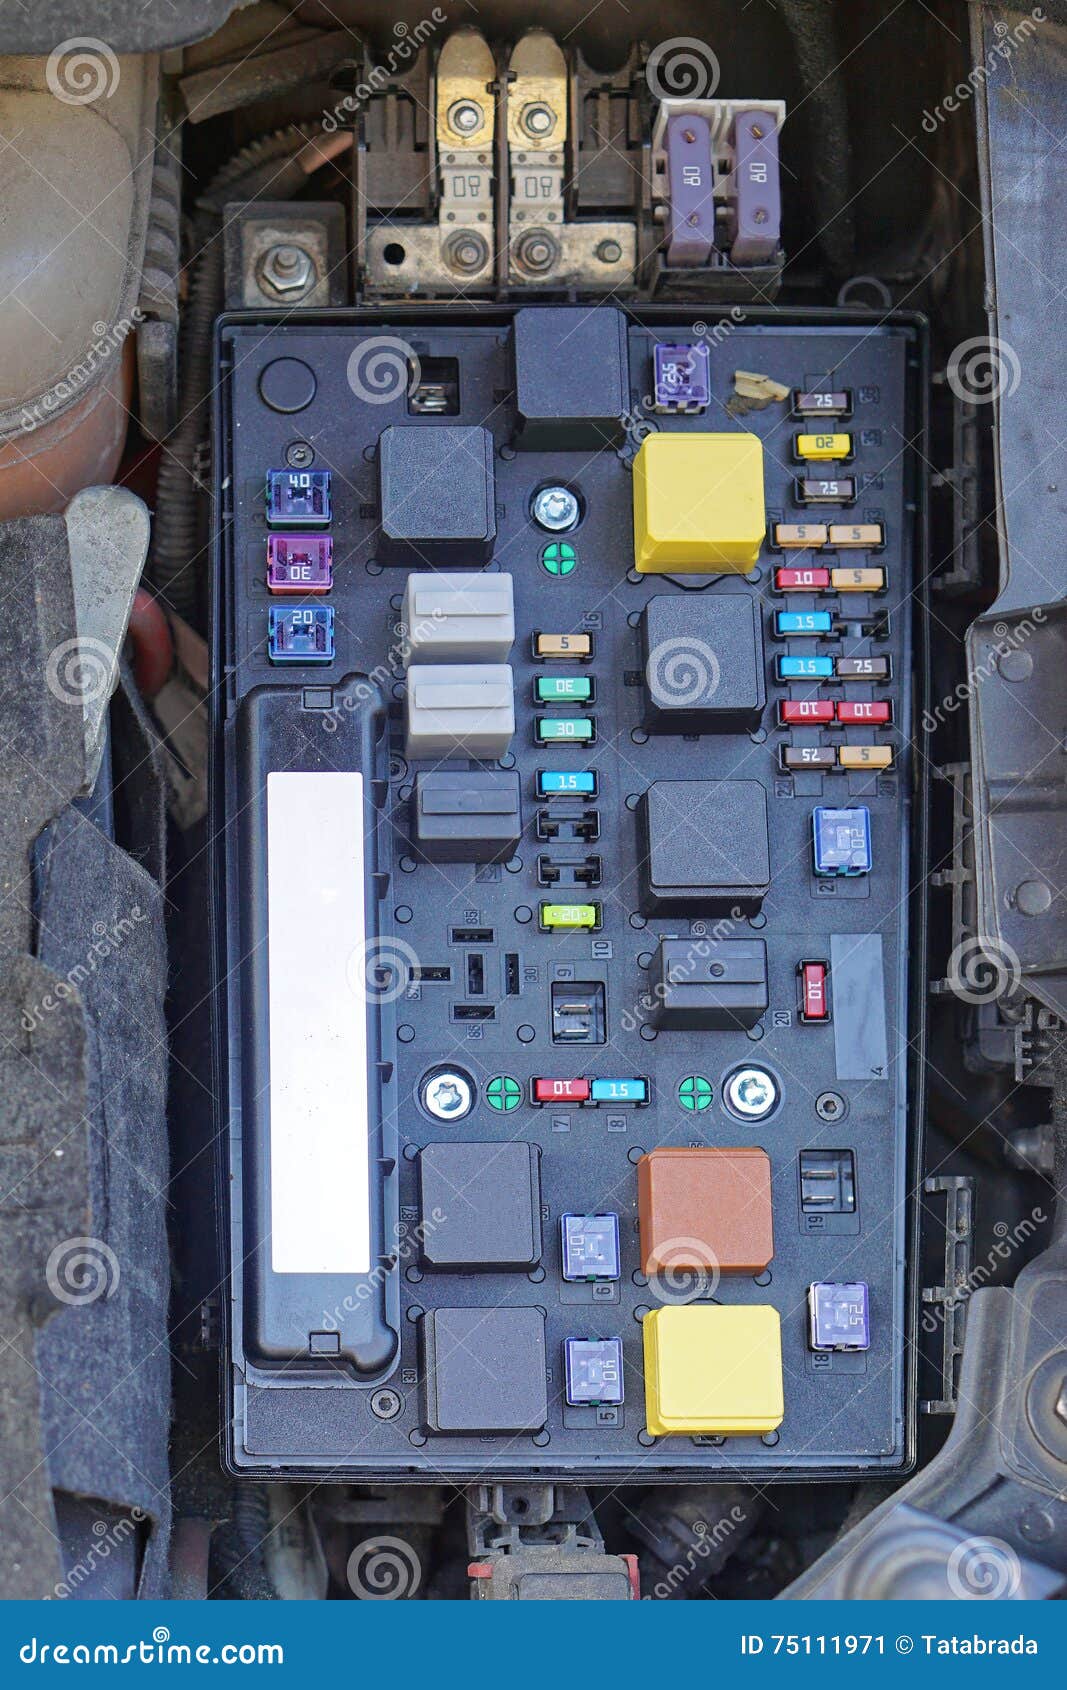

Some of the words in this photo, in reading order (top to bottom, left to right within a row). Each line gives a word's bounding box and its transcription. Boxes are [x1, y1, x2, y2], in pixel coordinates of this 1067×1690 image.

[816, 437, 834, 449] 20
[289, 473, 310, 488] 40
[797, 527, 806, 539] 5
[852, 528, 861, 540] 5
[290, 566, 311, 580] 30
[794, 572, 813, 585] 10
[854, 571, 862, 584] 5
[292, 610, 313, 624] 20
[796, 616, 815, 629] 15
[560, 637, 569, 649] 5
[798, 660, 816, 673] 15
[556, 679, 574, 692] 30
[800, 702, 818, 715] 10
[854, 703, 873, 716] 10
[556, 722, 574, 736] 30
[861, 749, 869, 761] 5
[559, 775, 577, 788] 15
[851, 828, 865, 849] 20
[560, 907, 580, 921] 20
[595, 941, 609, 957] 10
[524, 968, 537, 981] 30
[557, 968, 571, 977] 9
[808, 981, 821, 999] 10
[775, 1011, 790, 1026] 20
[871, 1066, 883, 1077] 4
[553, 1080, 572, 1095] 10
[609, 1083, 629, 1097] 15
[554, 1119, 569, 1128] 7
[610, 1120, 625, 1128] 8
[808, 1216, 823, 1229] 19
[570, 1234, 585, 1256] 40
[596, 1286, 611, 1295] 6
[850, 1304, 864, 1325] 25
[815, 1354, 829, 1368] 18
[404, 1369, 417, 1383] 30
[602, 1360, 617, 1381] 40
[600, 1411, 615, 1420] 5
